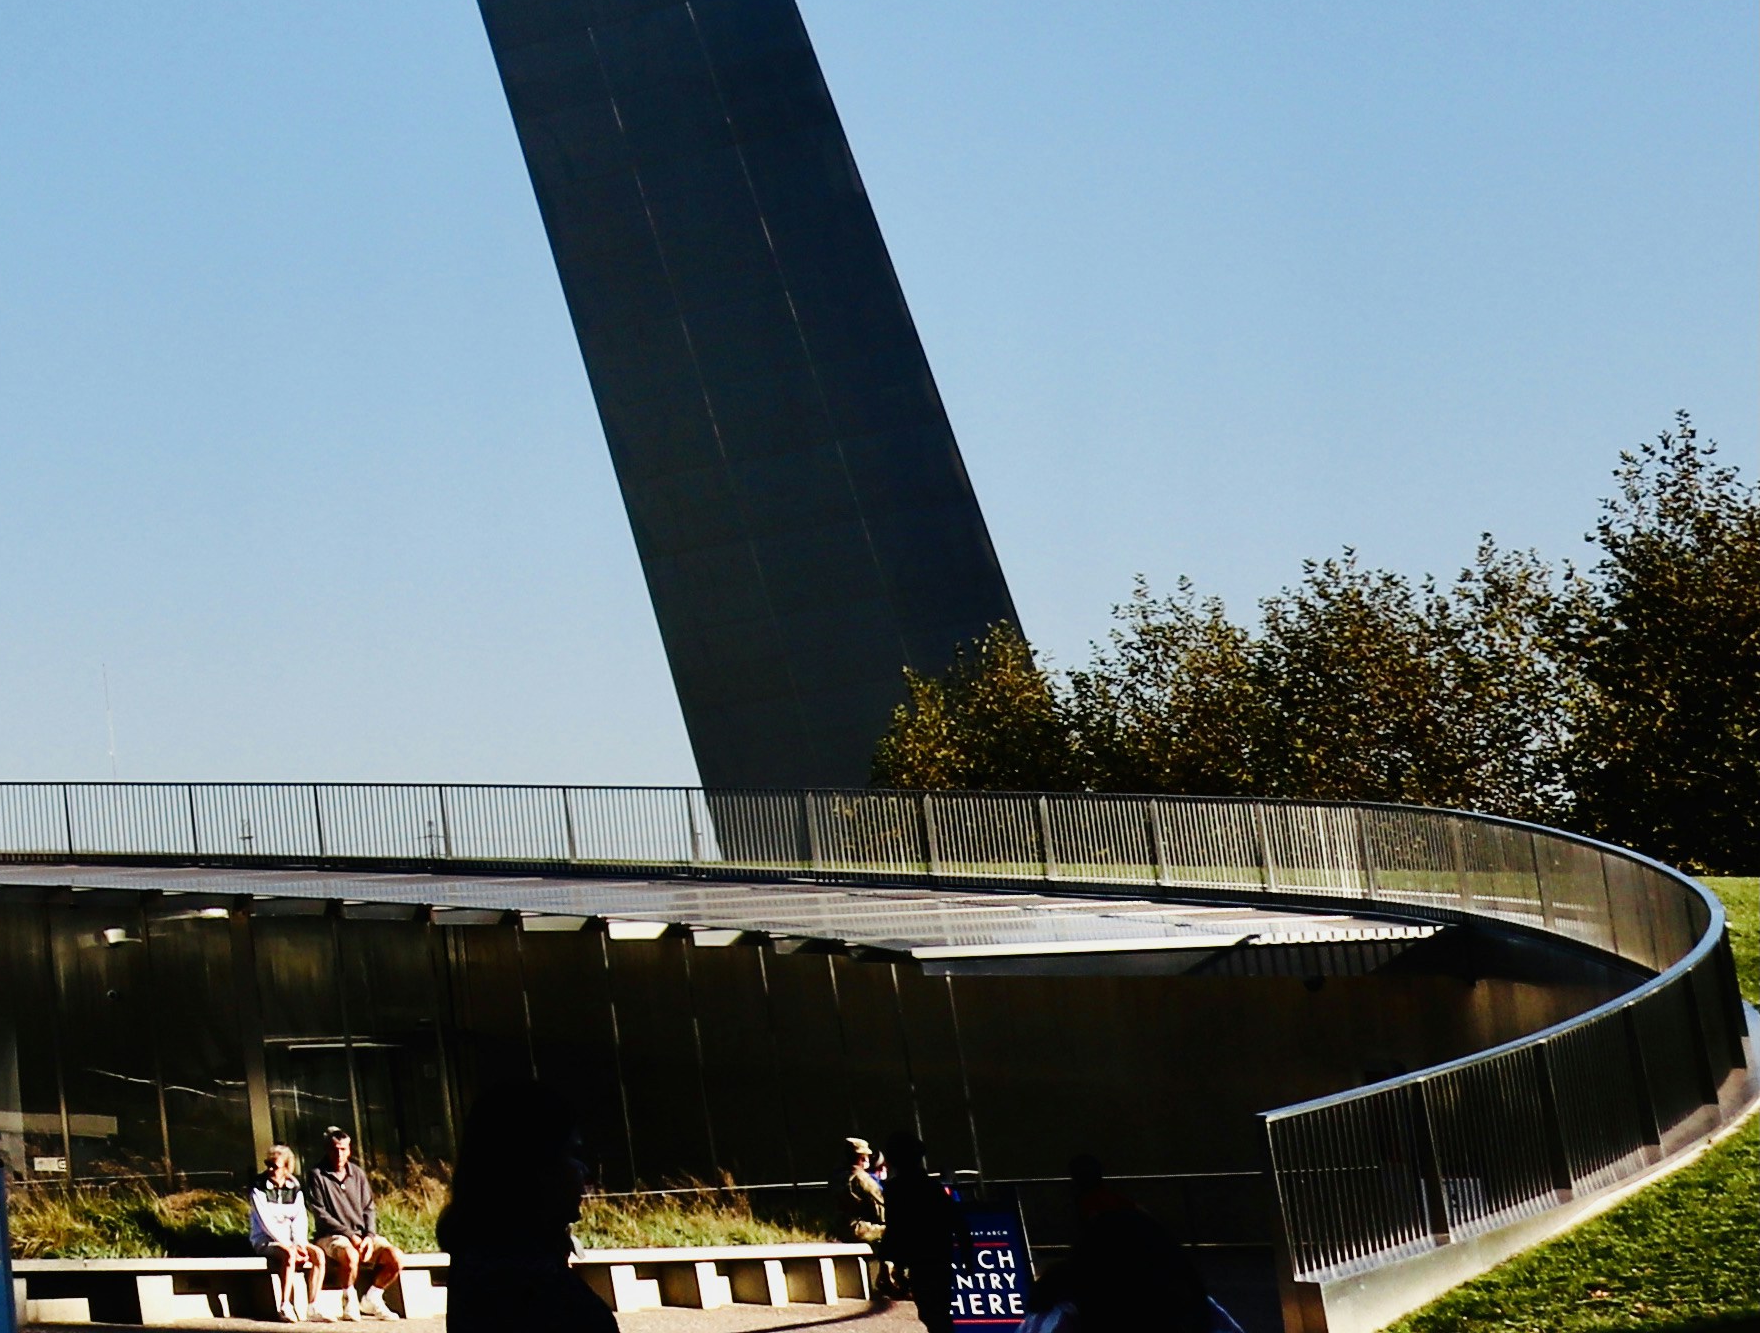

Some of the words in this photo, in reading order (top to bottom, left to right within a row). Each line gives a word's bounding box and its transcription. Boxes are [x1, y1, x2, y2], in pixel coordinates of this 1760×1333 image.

[951, 1249, 1016, 1269] CH
[951, 1272, 1016, 1290] NTRY
[949, 1293, 1025, 1315] HERE
